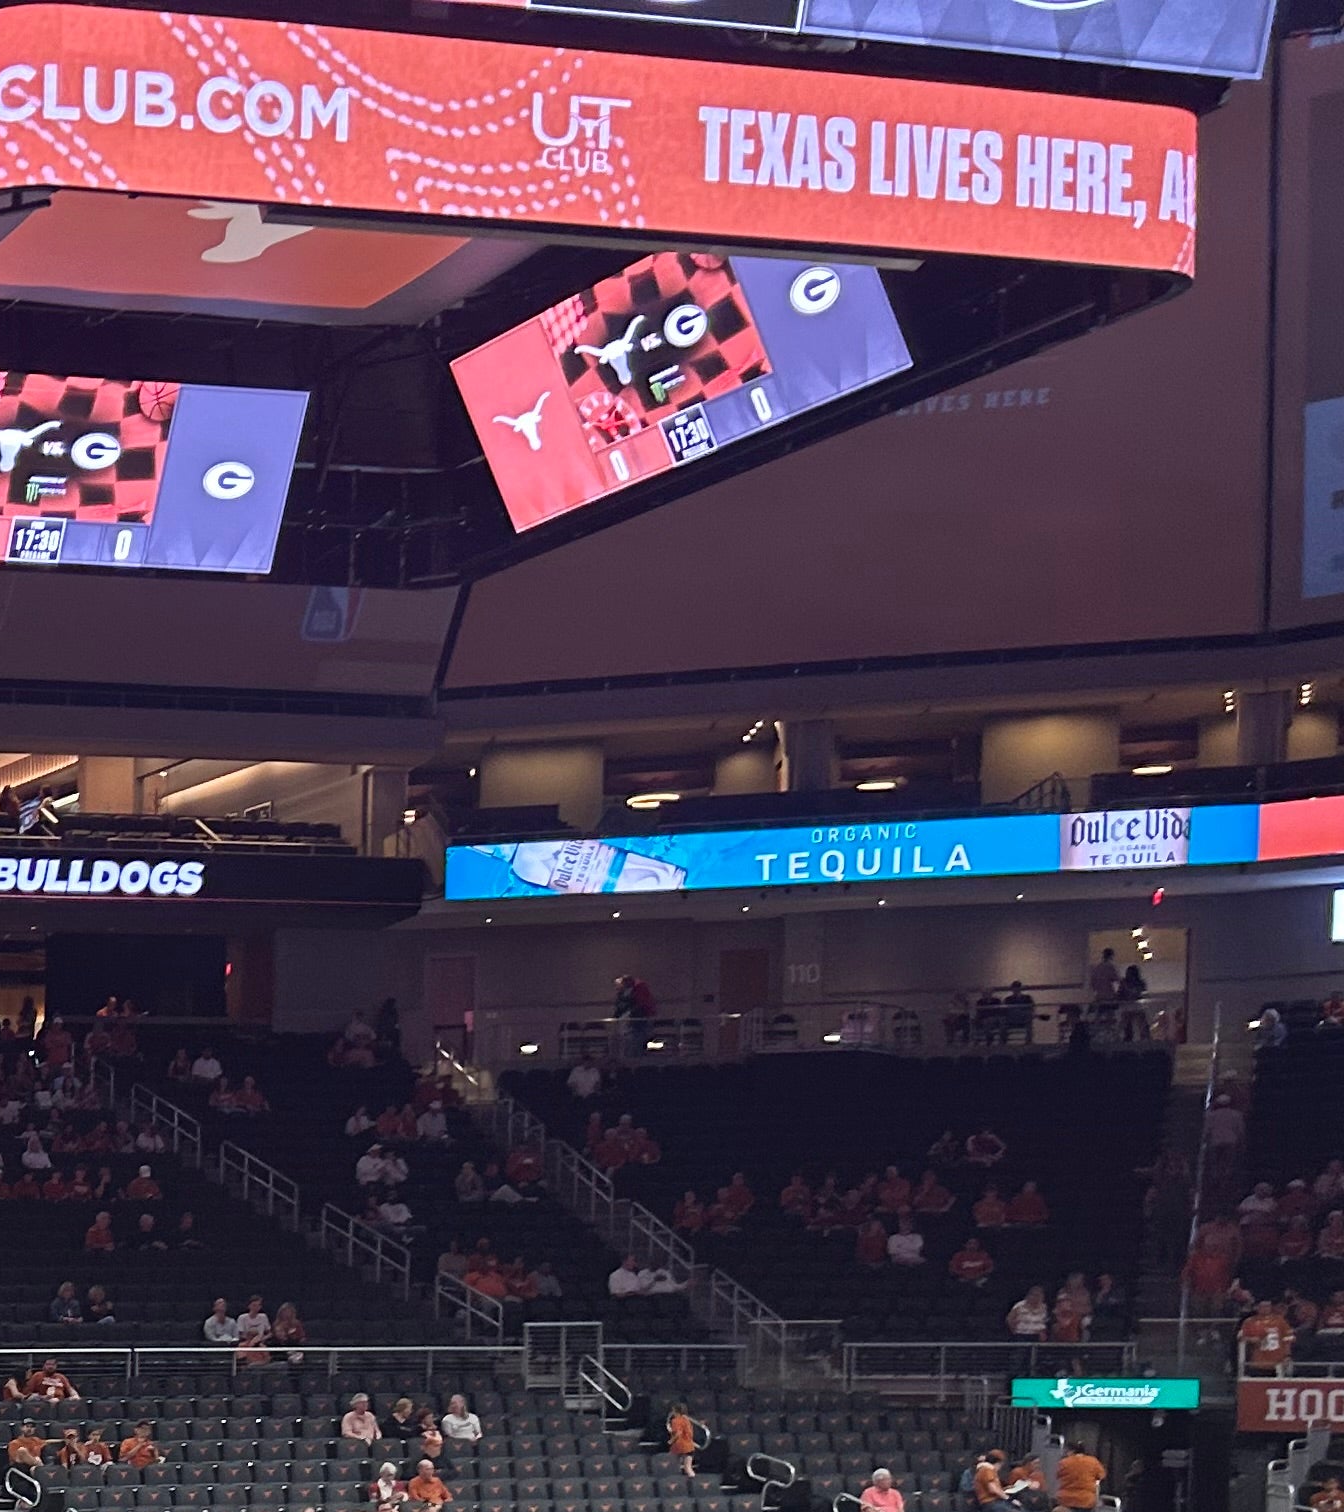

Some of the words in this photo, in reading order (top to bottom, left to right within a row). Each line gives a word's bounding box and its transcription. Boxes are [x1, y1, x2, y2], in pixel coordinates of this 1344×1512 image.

[541, 147, 610, 175] CLUB
[699, 105, 857, 192] TEXAS
[869, 120, 1002, 206] LIVES
[1015, 136, 1148, 230] HERE,
[750, 386, 772, 422] 0
[668, 417, 710, 452] 17:30
[609, 450, 630, 481] 0
[15, 528, 61, 551] 17:30
[114, 529, 133, 561] 0
[812, 824, 918, 843] ORGANIC
[755, 844, 973, 882] TEQUILA
[1090, 851, 1176, 866] TEQUILA
[1082, 1383, 1161, 1398] Germania
